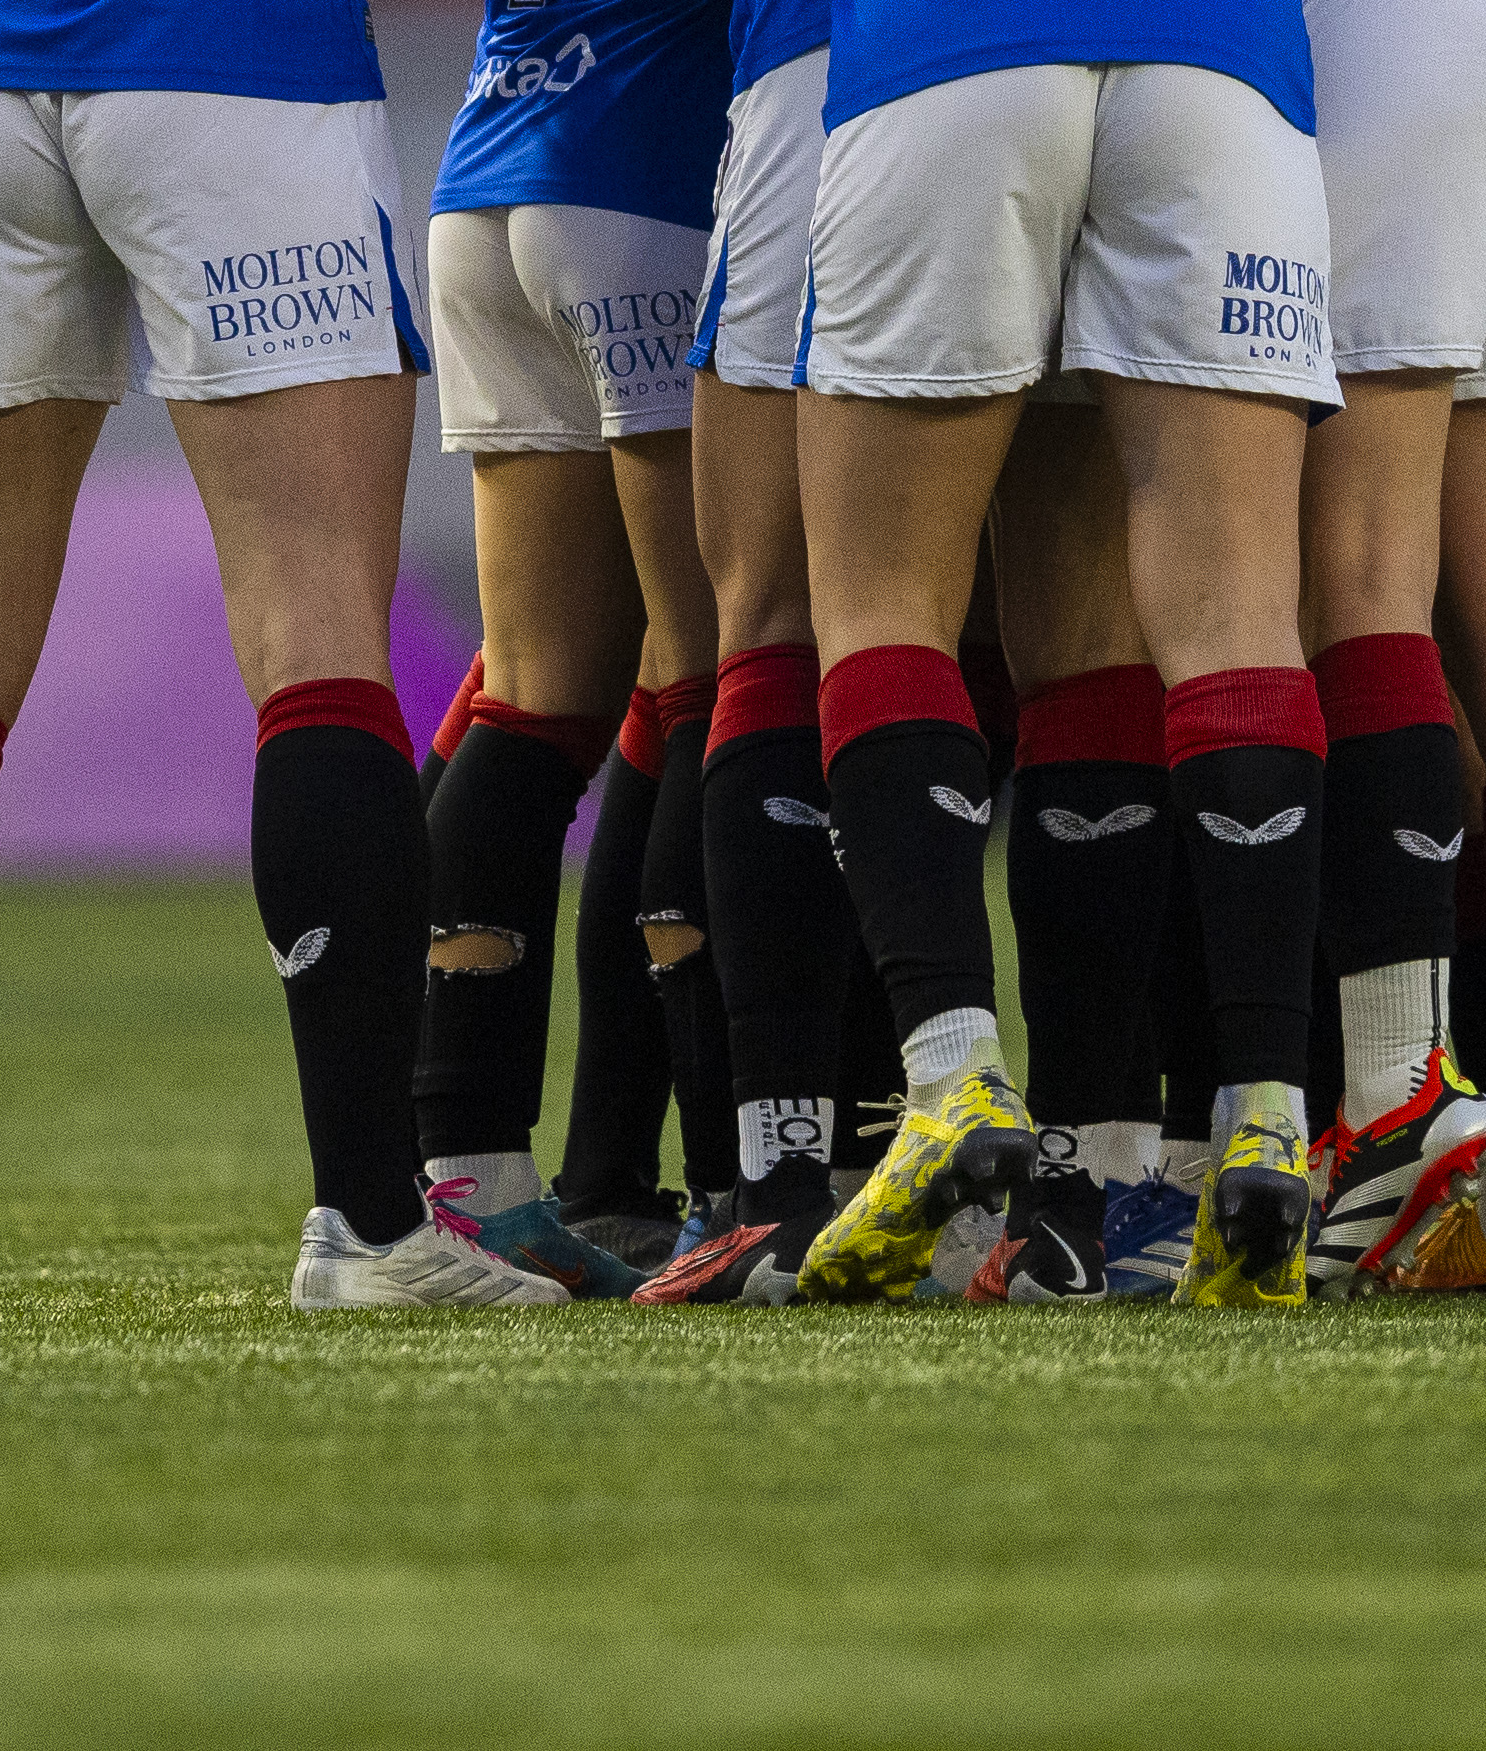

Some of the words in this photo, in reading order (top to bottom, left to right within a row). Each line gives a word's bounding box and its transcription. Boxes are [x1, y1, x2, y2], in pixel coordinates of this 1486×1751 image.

[201, 236, 367, 297] MOLTON
[1223, 251, 1325, 310] MOLTON
[207, 281, 375, 342] BROWN
[1218, 296, 1322, 358] BROWN
[247, 329, 351, 357] LONDON
[579, 333, 695, 380] ROW
[1249, 345, 1316, 370] LONO
[605, 377, 688, 401] ONDON
[759, 1101, 773, 1148] UTBOL
